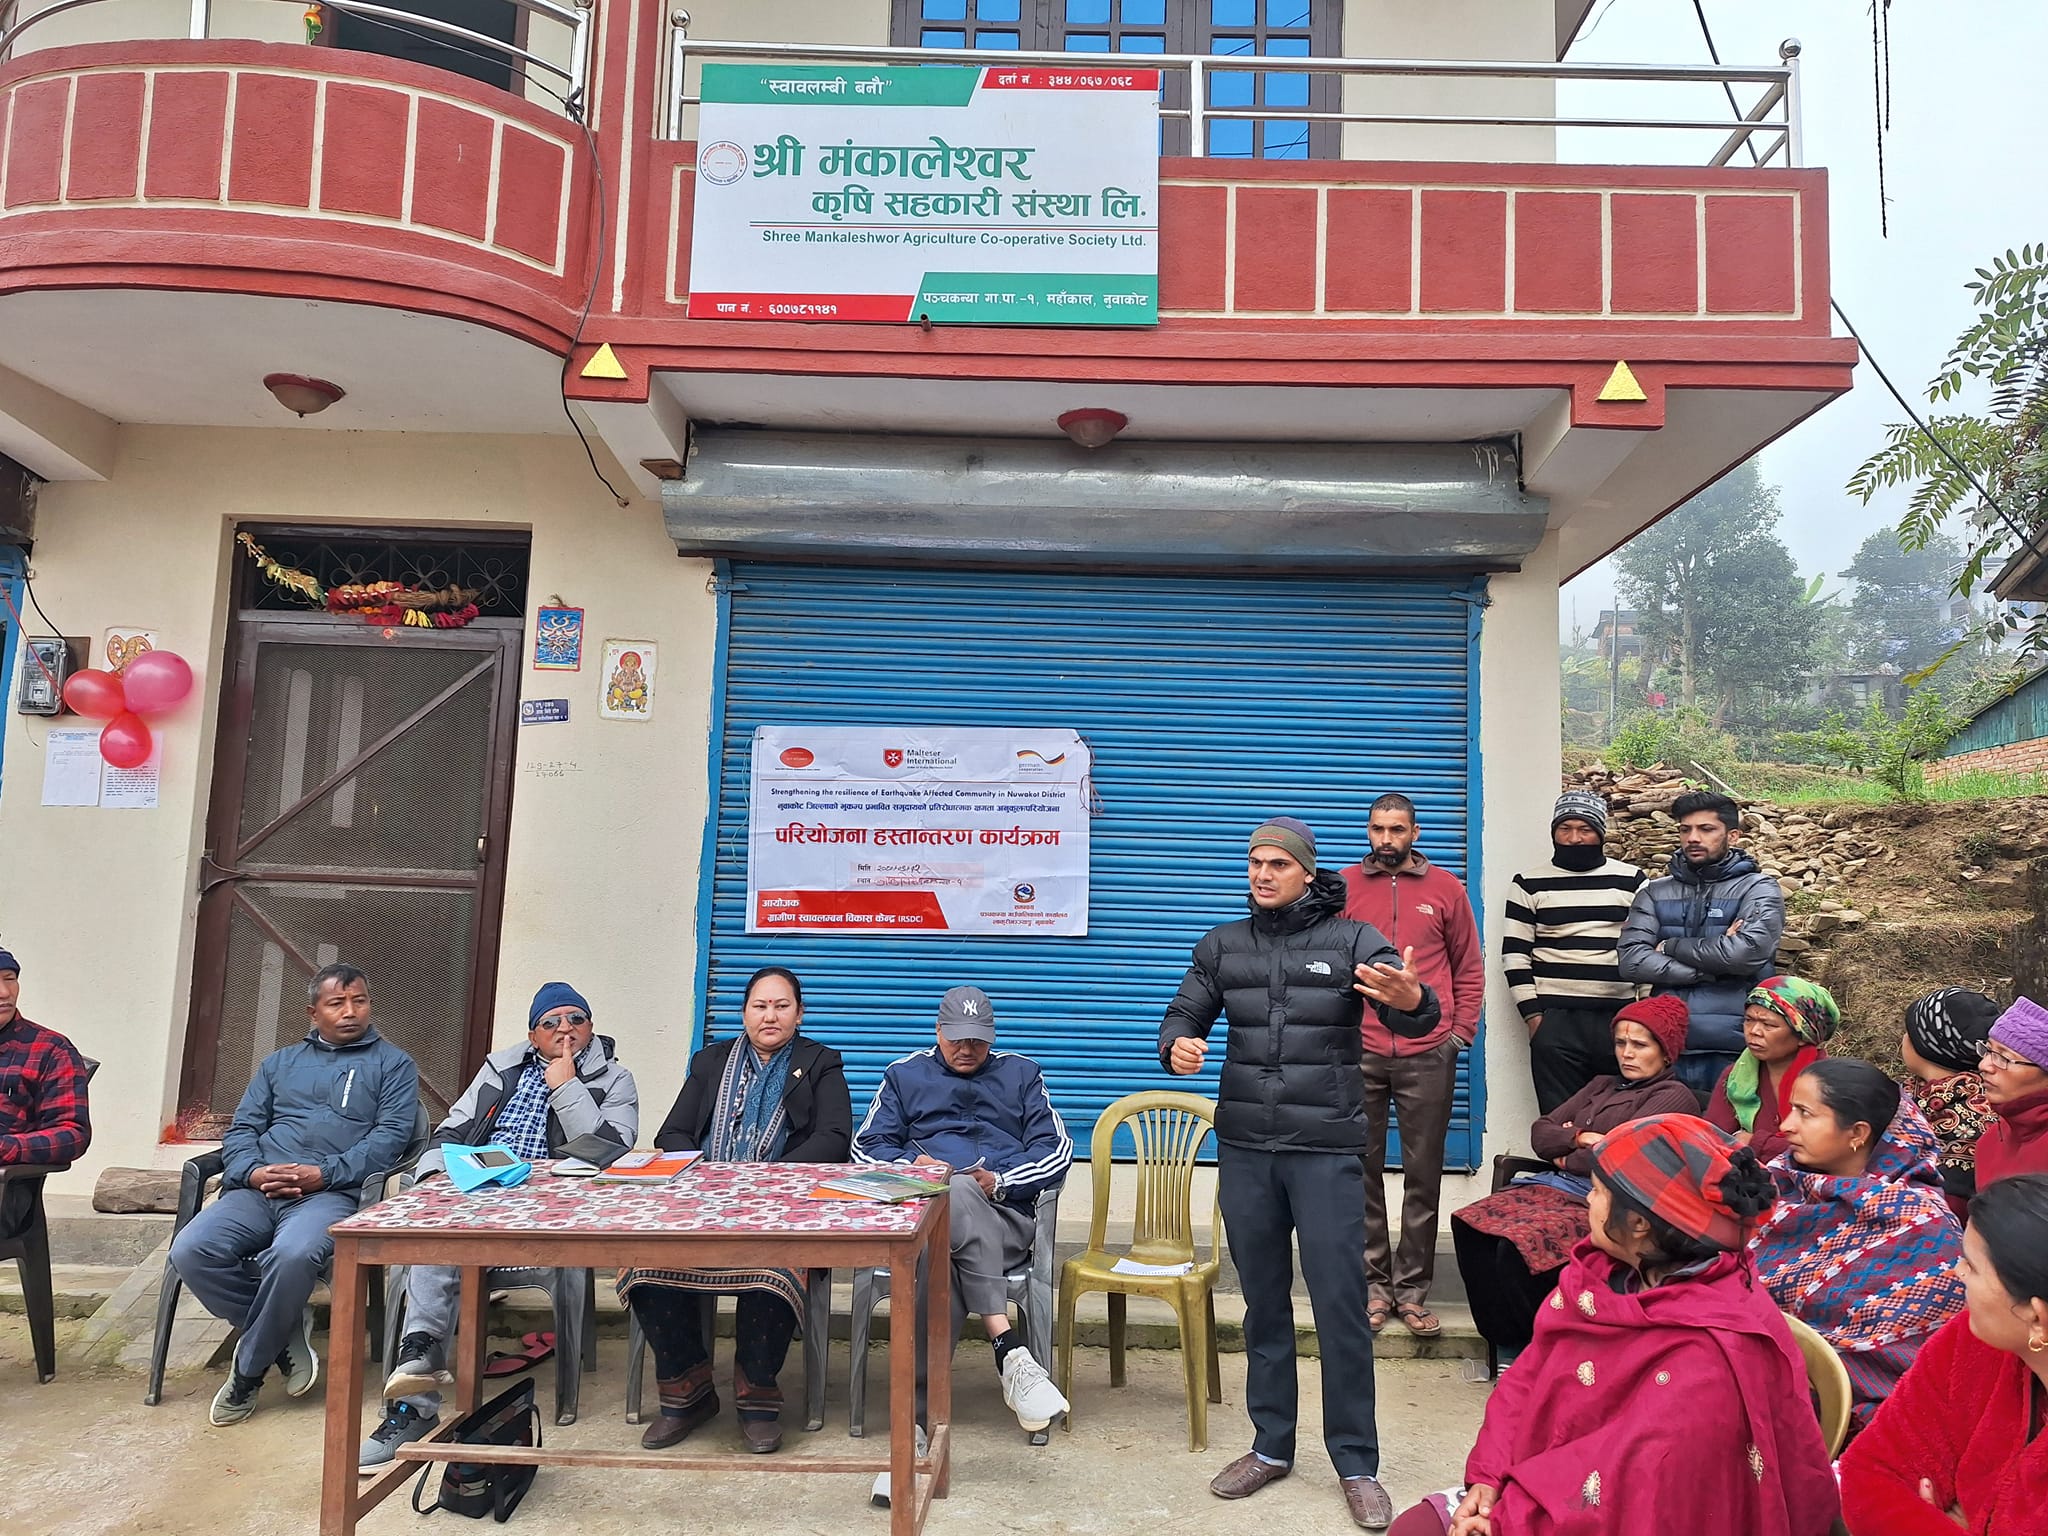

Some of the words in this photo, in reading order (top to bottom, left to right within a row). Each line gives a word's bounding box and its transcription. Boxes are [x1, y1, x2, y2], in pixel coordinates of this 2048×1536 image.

[998, 73, 1017, 85] दर्ता
[1048, 76, 1132, 86] ३४४/०६७/०६८
[753, 135, 806, 178] श्री
[819, 136, 1035, 181] मंकालेश्वर
[812, 184, 875, 221] कृषि
[884, 186, 1002, 217] सहकारी
[1012, 189, 1092, 218] संस्था
[1101, 187, 1146, 218] लि.
[762, 230, 800, 242] Shree
[805, 231, 900, 244] Mankaleshwor
[903, 232, 976, 246] Agriculture
[980, 233, 1064, 247] Co-operative
[1068, 234, 1117, 248] Society
[1122, 234, 1146, 246] Ltd.
[923, 293, 980, 303] पञ्चकन्या
[1103, 292, 1149, 308] नुवाकोट
[716, 303, 737, 313] पान
[768, 304, 837, 315] ६००७८११४१
[906, 749, 941, 757] Malteser
[771, 787, 820, 797] Strengthening
[822, 788, 833, 796] the
[835, 788, 869, 796] resilience
[871, 788, 879, 796] of
[881, 789, 921, 798] Earthquake
[924, 789, 953, 797] Affected
[955, 790, 996, 798] Community
[775, 822, 868, 844] परियोजना
[874, 828, 973, 846] हस्तान्तरण
[979, 825, 1060, 846] कार्यक्रम
[762, 898, 799, 907] आयोजक
[768, 912, 795, 922] ग्रामीण
[799, 914, 843, 923] स्वावलम्बन
[845, 912, 873, 923] विकास
[875, 912, 896, 923] केन्द्र
[898, 915, 924, 923] (RSDC)
[963, 999, 979, 1016] NY
